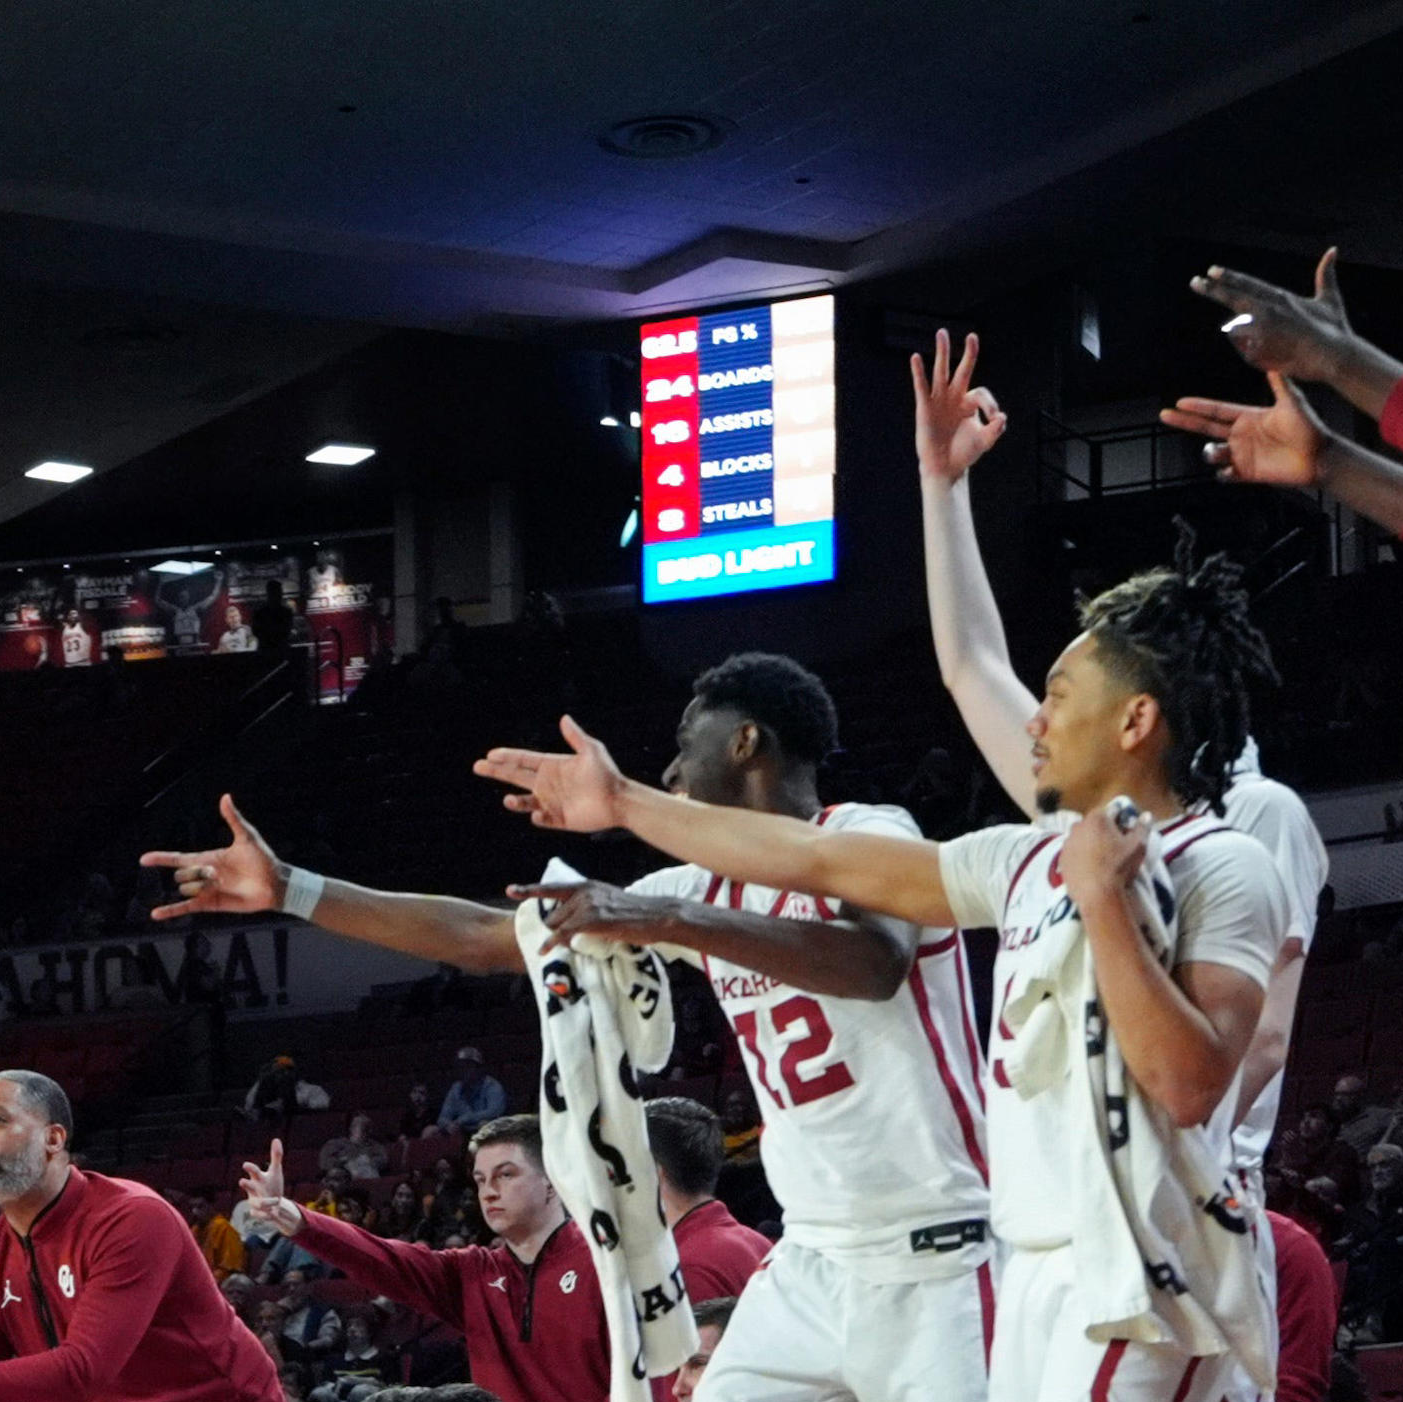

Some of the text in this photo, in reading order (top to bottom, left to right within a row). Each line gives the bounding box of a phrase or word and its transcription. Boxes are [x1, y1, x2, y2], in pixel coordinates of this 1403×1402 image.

[698, 365, 774, 391] BOARDS
[699, 409, 774, 435] ASSISTS
[657, 464, 685, 487] 4
[700, 453, 772, 478] BLOCKS
[702, 498, 773, 523] STEALS
[657, 540, 816, 585] BUD LIGHT
[733, 995, 857, 1111] 12
